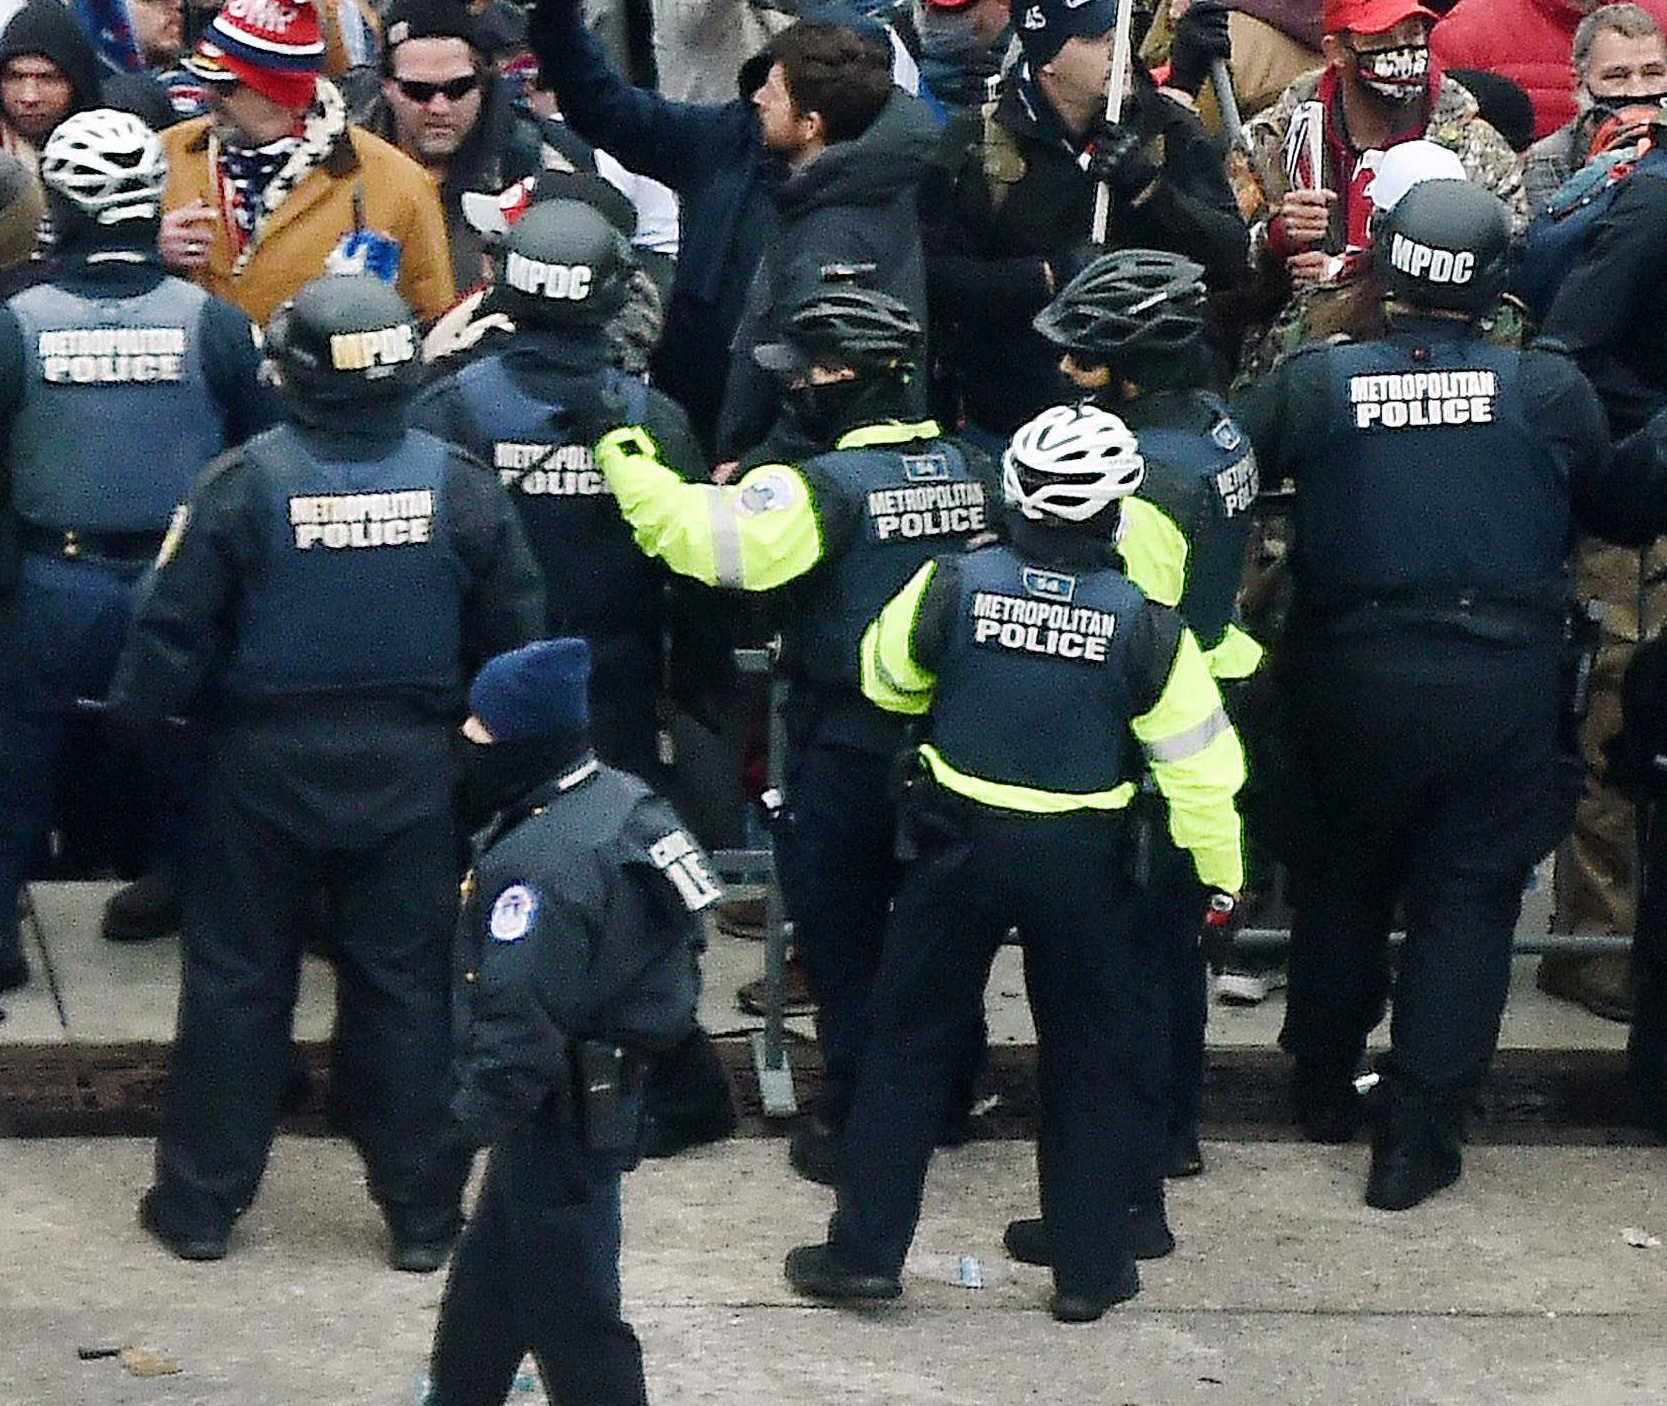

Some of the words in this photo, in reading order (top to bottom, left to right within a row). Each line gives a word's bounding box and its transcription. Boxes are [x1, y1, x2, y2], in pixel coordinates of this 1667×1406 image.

[1024, 5, 1047, 31] 45
[505, 251, 593, 301] MPDC
[1391, 232, 1475, 285] MPDC
[43, 355, 184, 384] POLICE
[1350, 370, 1496, 403] METROPOLITAN
[1355, 396, 1494, 429] POLICE
[498, 469, 609, 496] POLIC
[868, 481, 986, 517] METROPOLITAN
[294, 514, 433, 550] POLICE
[878, 505, 988, 540] POLICE
[972, 592, 1118, 639] METROPOLITAN
[973, 615, 1114, 663] POLICE
